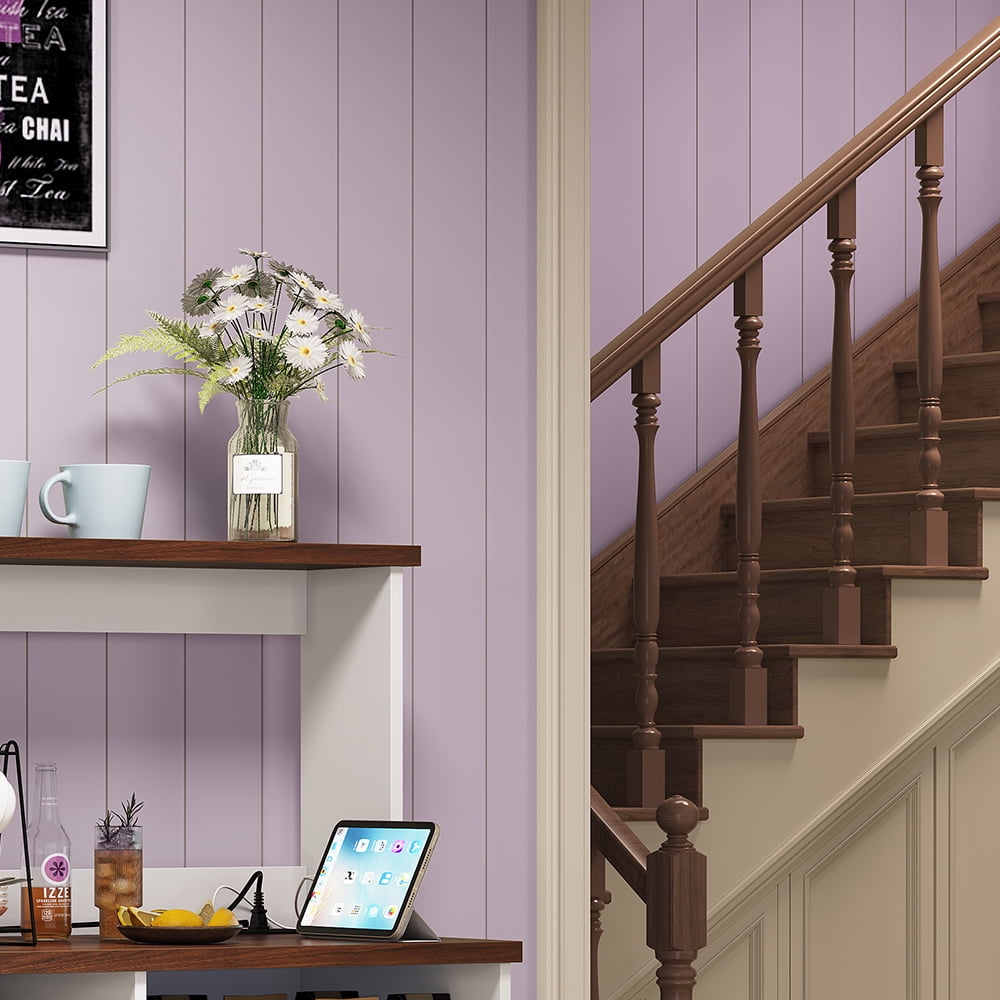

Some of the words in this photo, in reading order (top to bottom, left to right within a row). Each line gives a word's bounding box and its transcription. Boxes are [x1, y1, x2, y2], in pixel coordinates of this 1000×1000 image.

[22, 116, 70, 142] CHAI
[20, 174, 71, 200] Tea
[43, 887, 70, 898] IZZE
